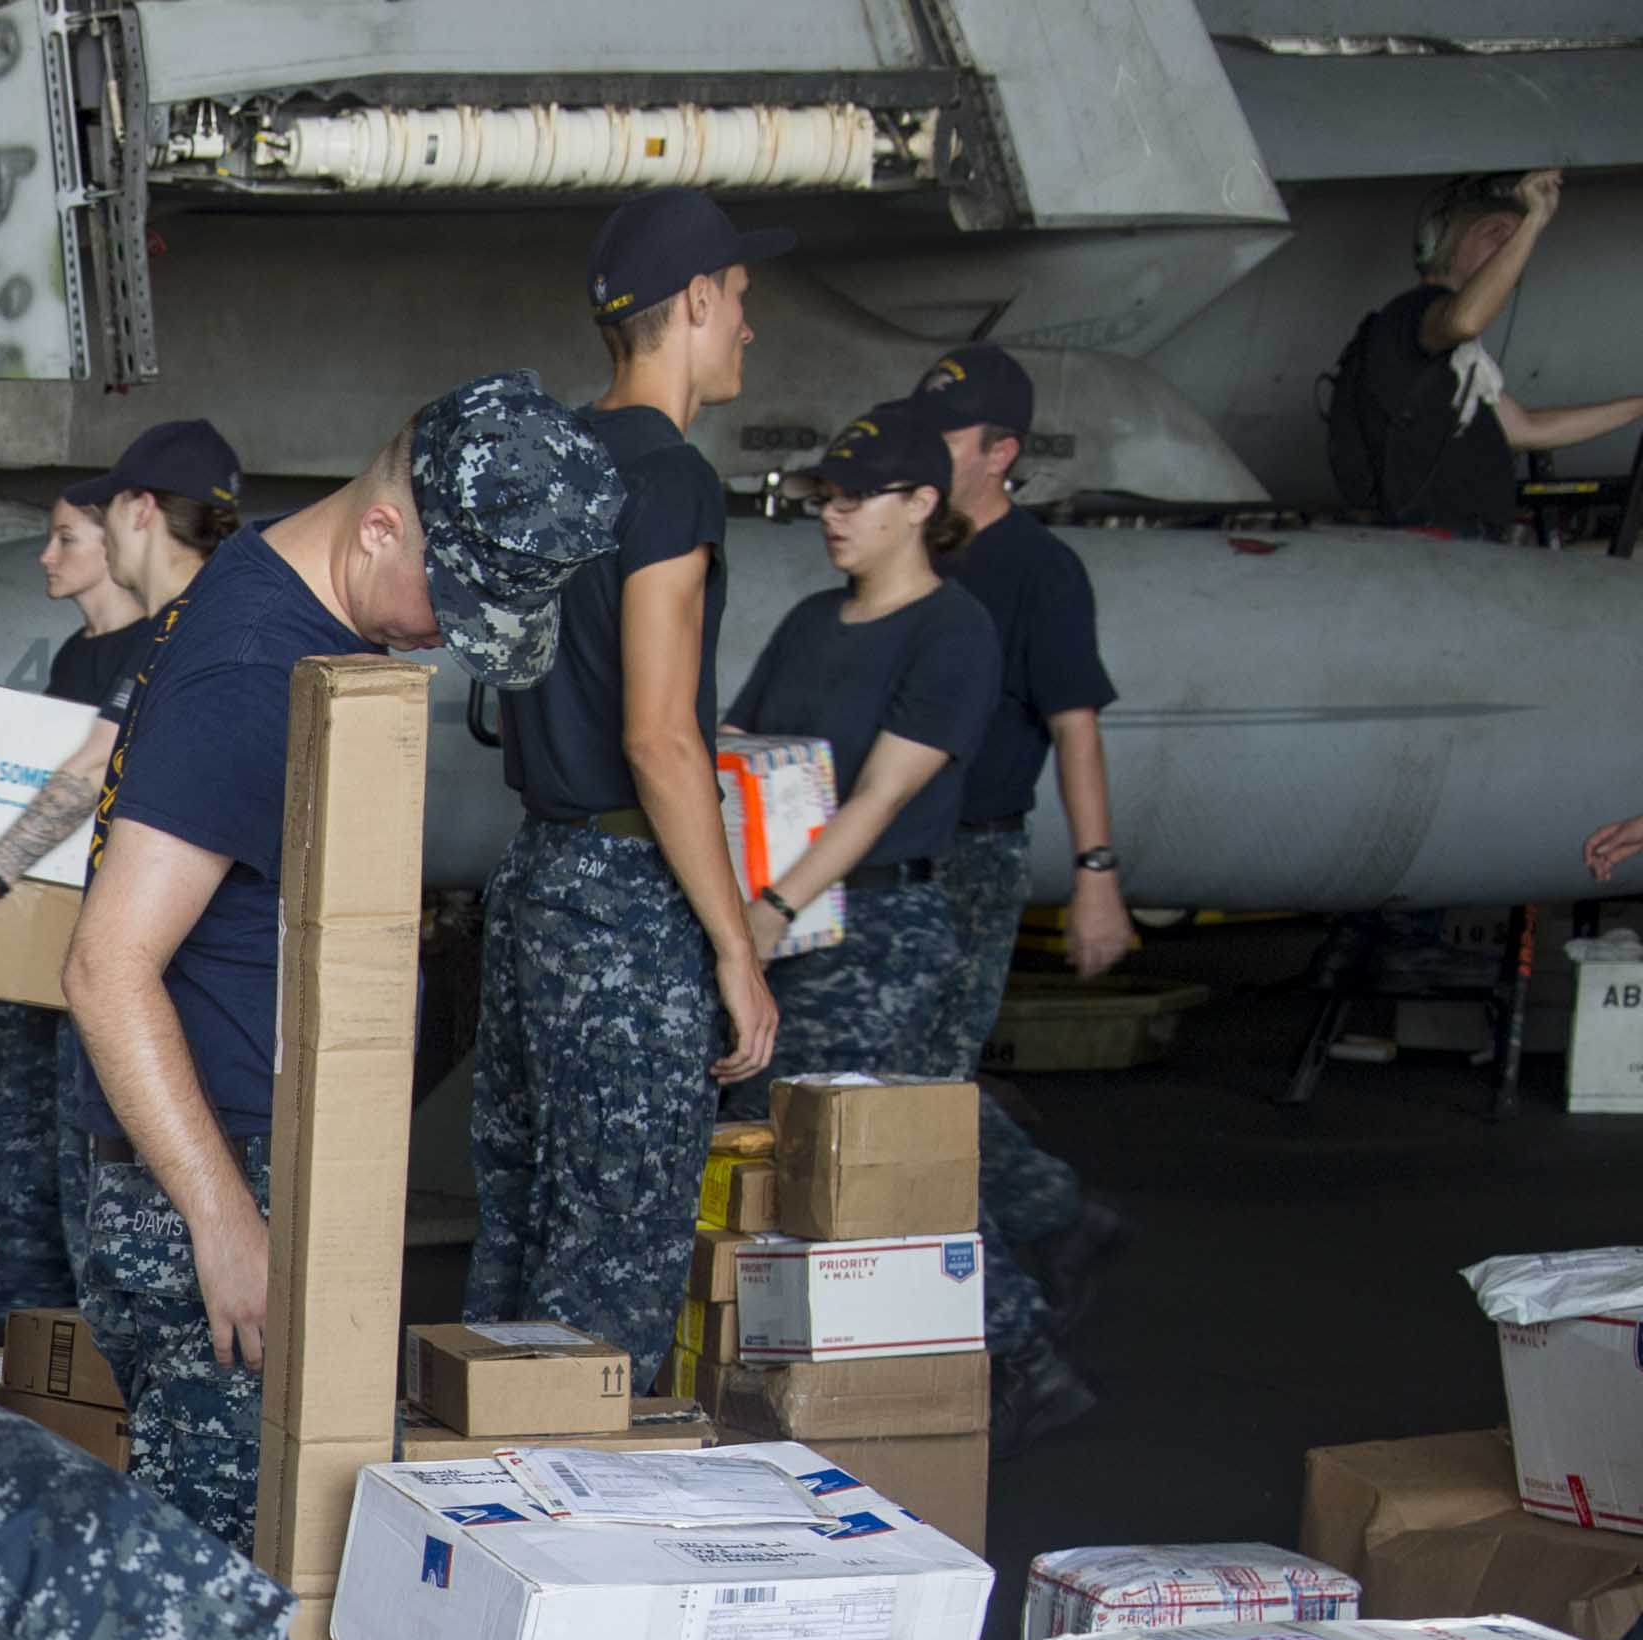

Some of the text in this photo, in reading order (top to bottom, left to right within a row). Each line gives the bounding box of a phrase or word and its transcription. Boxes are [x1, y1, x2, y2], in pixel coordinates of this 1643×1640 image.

[576, 857, 608, 879] RAY
[131, 1209, 185, 1237] DAVIS
[819, 1257, 879, 1271] PRIORITY
[832, 1269, 865, 1280] MAIL
